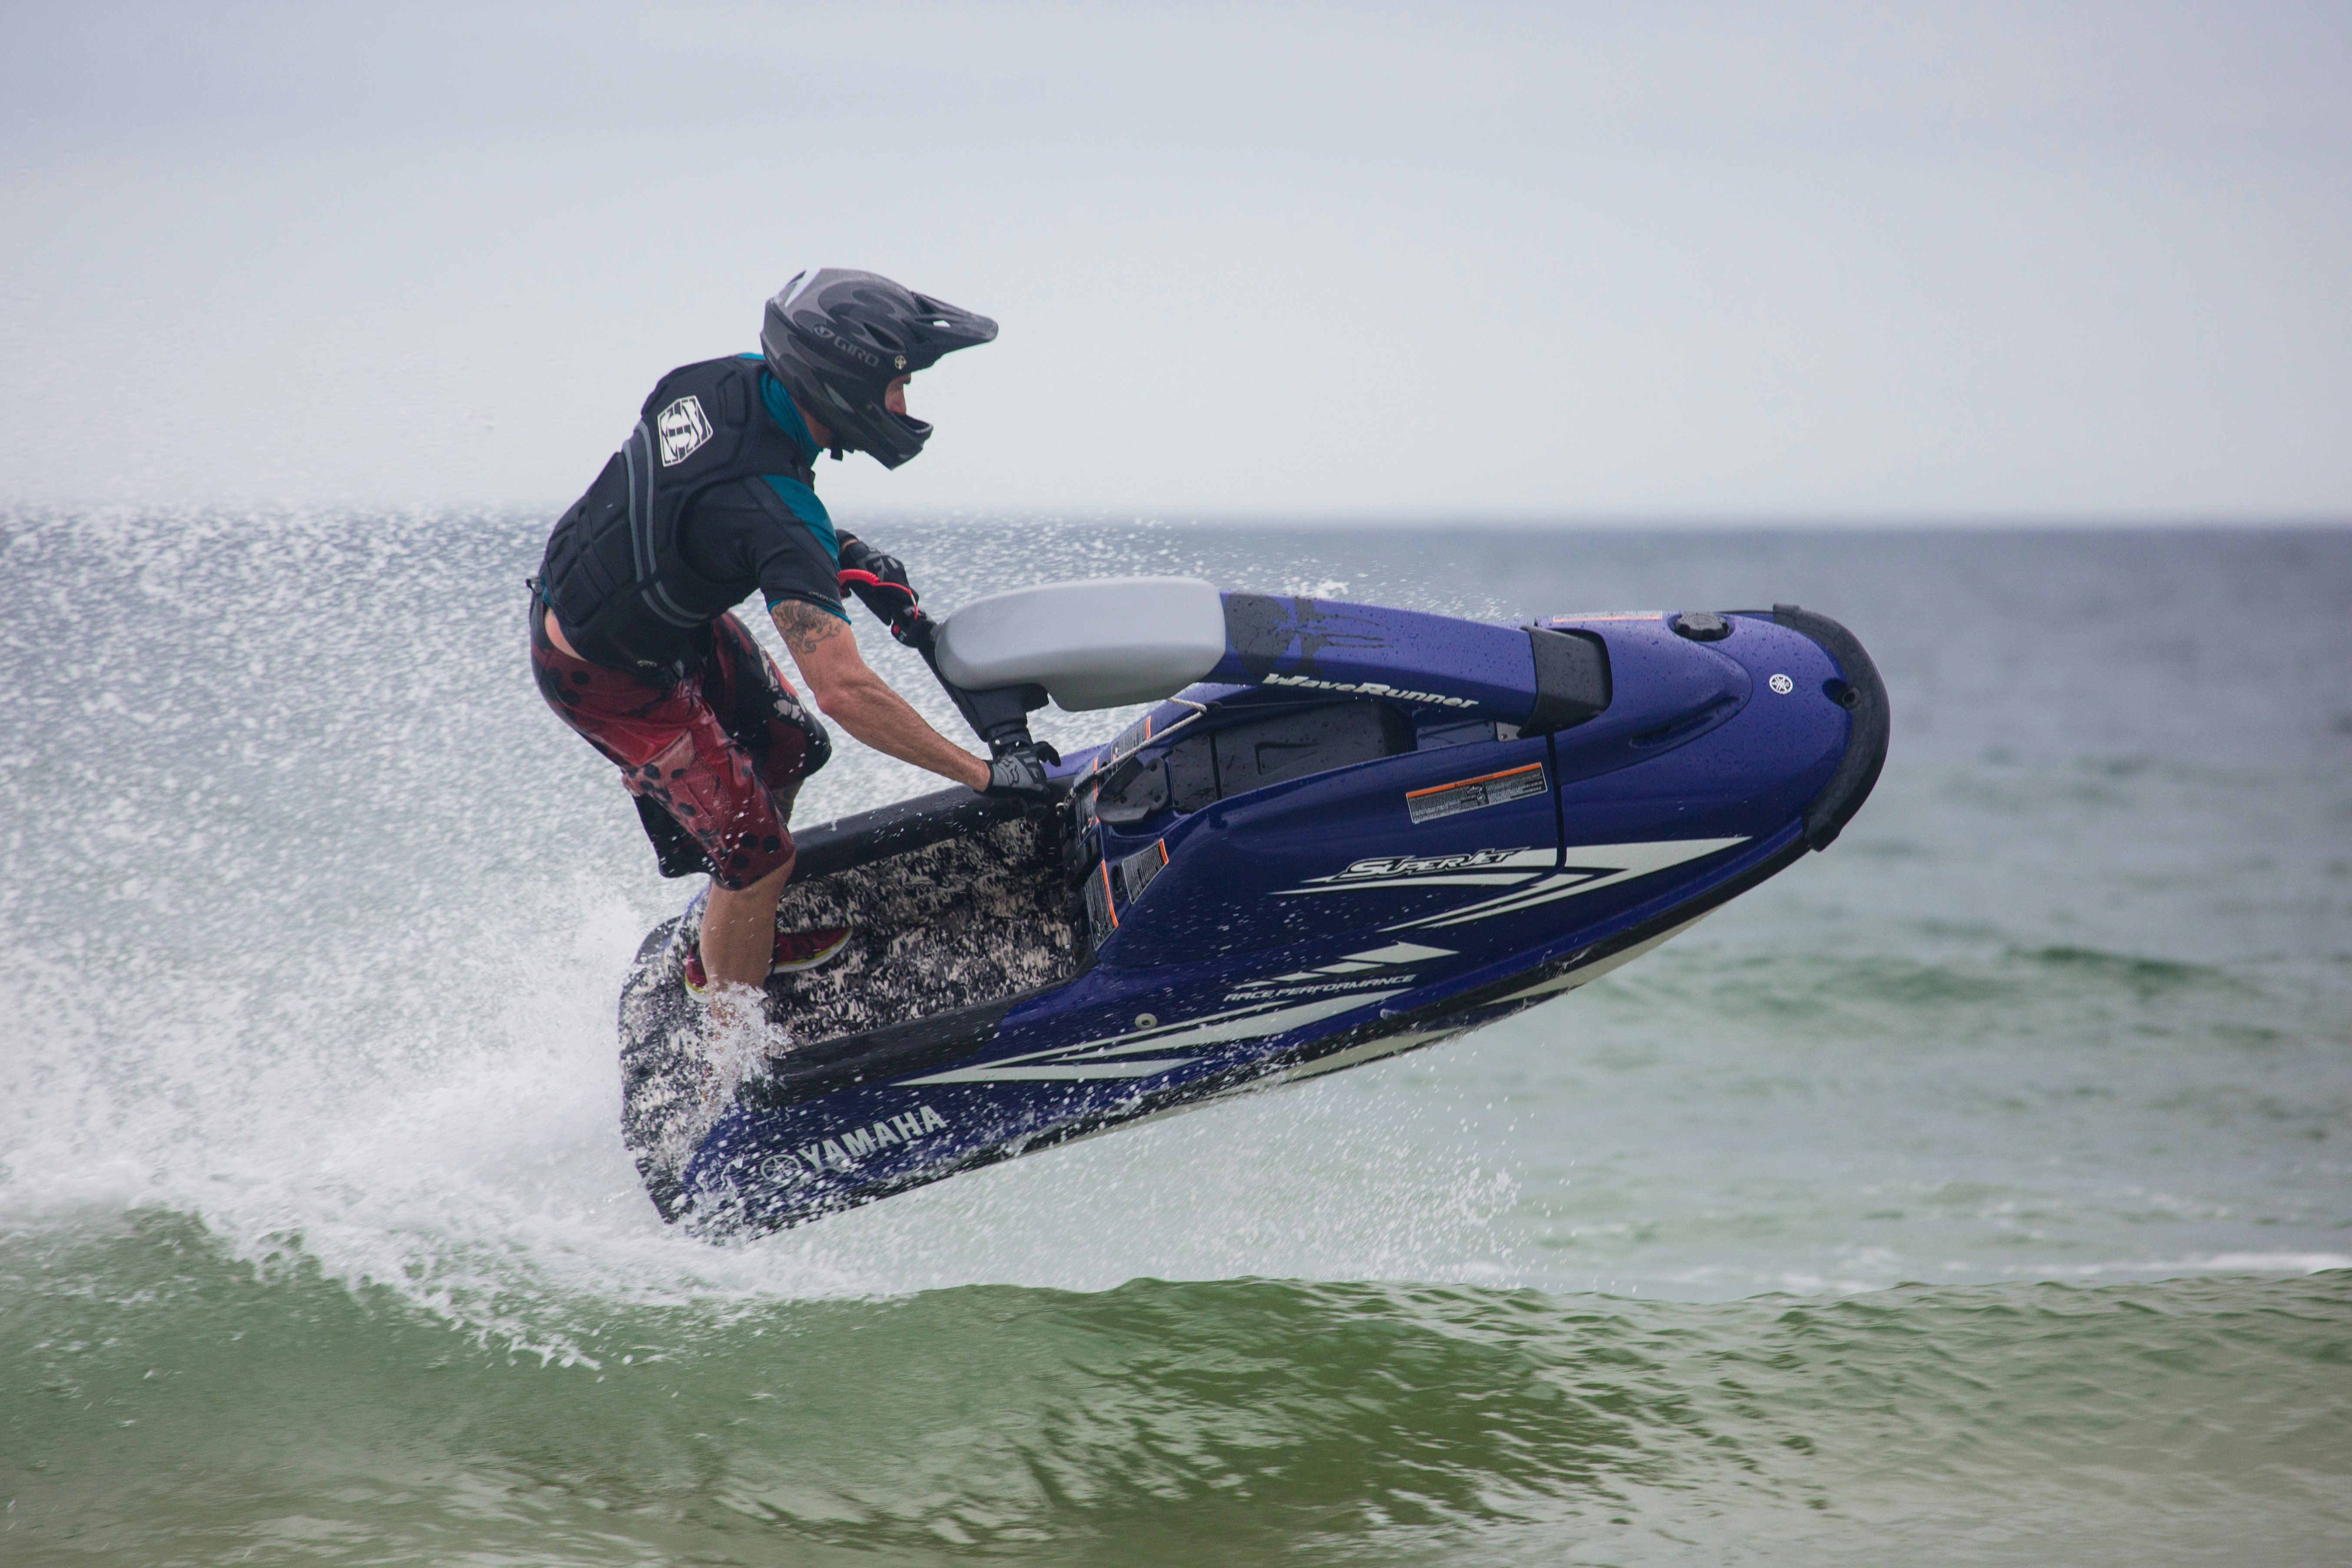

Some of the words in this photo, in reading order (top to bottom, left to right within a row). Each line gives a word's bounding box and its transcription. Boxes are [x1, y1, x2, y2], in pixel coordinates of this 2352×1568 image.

[834, 336, 879, 367] GIRO
[1262, 673, 1479, 708] WaveRunner
[1223, 989, 1275, 1002] RACE
[1275, 974, 1419, 997] PERFORMANCE
[797, 1105, 948, 1170] YAMAHA
